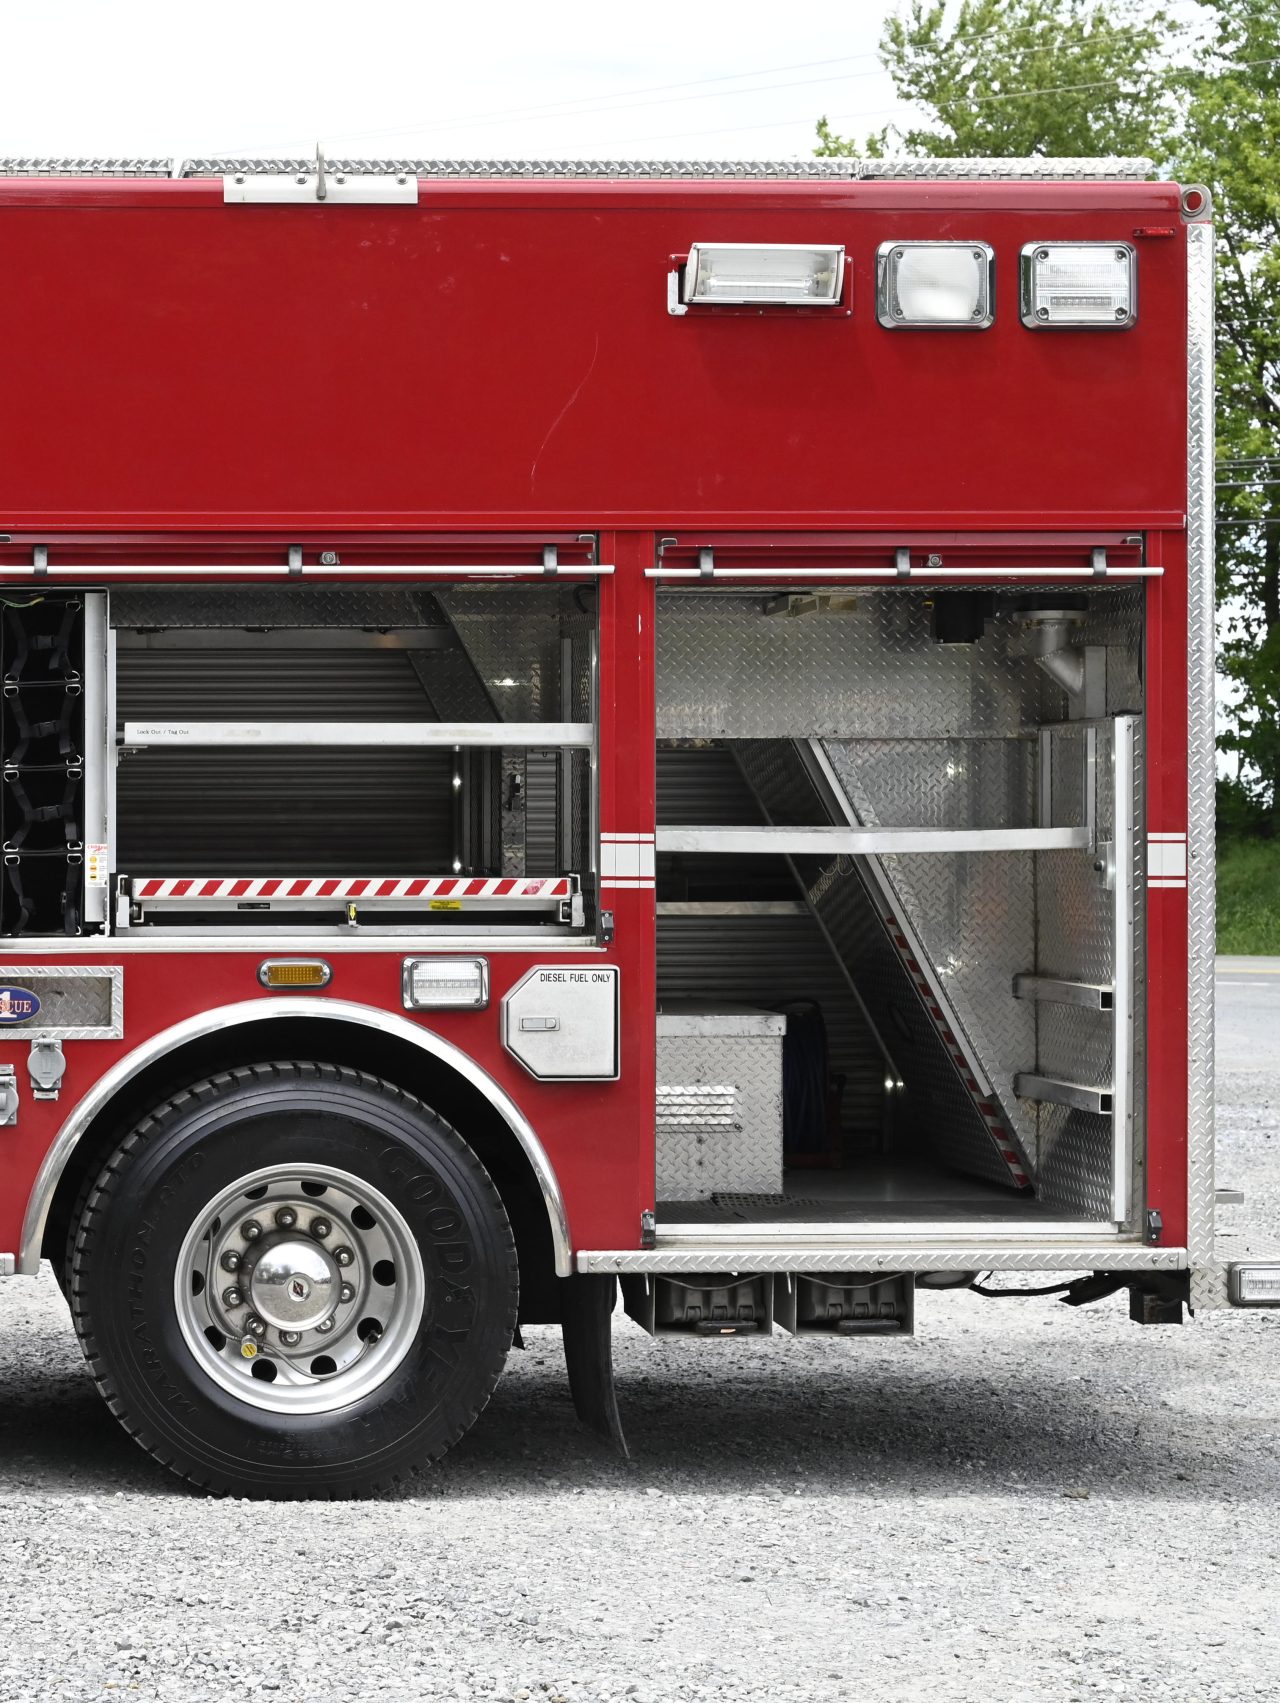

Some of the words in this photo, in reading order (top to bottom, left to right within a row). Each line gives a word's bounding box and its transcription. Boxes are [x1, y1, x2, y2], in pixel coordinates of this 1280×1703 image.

[540, 973, 567, 983] DIESEL
[569, 973, 589, 983] FUEL
[591, 973, 611, 983] ONLY
[128, 1218, 199, 1417] MARATHON
